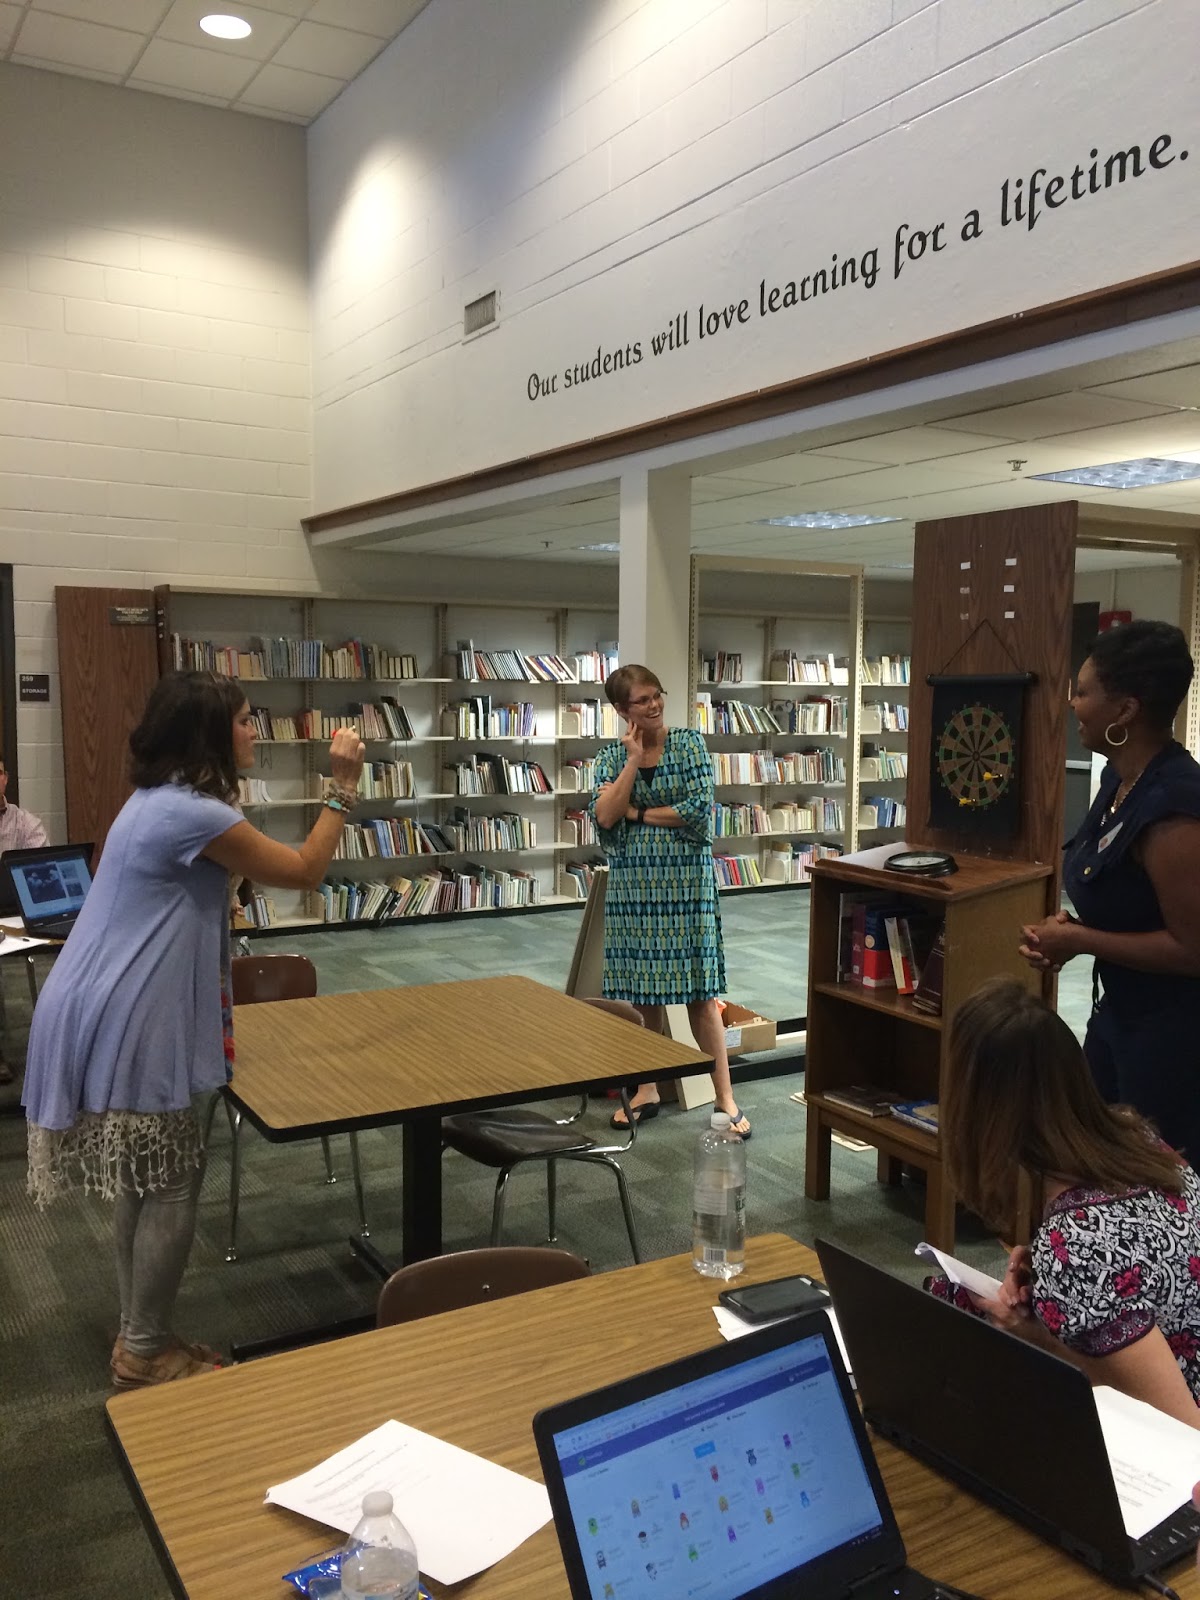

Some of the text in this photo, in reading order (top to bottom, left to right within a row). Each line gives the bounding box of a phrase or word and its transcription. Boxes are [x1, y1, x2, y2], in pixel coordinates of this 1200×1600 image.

[527, 134, 1189, 401] Our students will love learning for a lifetime.
